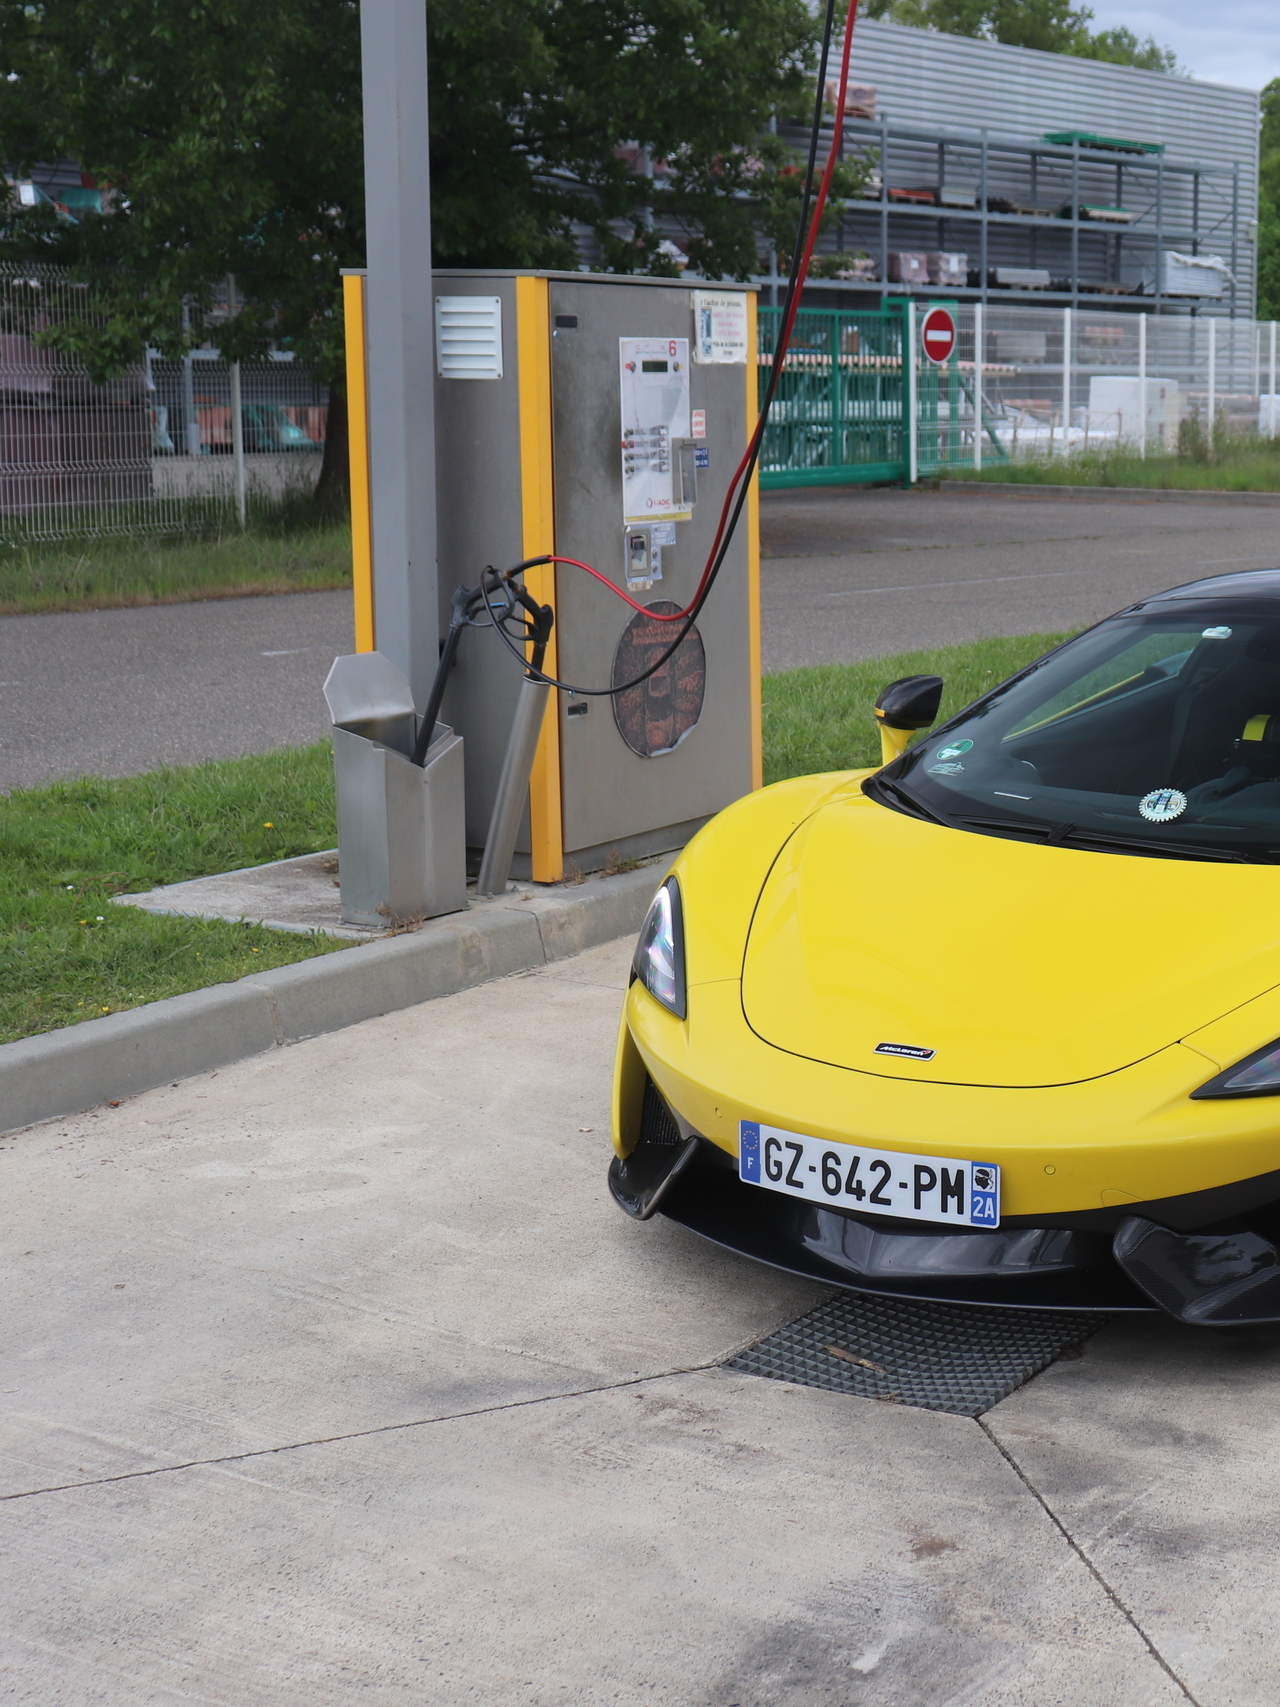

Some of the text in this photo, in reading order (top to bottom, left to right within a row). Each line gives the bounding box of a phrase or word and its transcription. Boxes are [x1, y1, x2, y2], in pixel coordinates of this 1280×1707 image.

[879, 1045, 924, 1056] McLaren
[746, 1156, 754, 1169] F
[763, 1136, 965, 1215] GZ-642-PM
[972, 1196, 995, 1220] 2A
